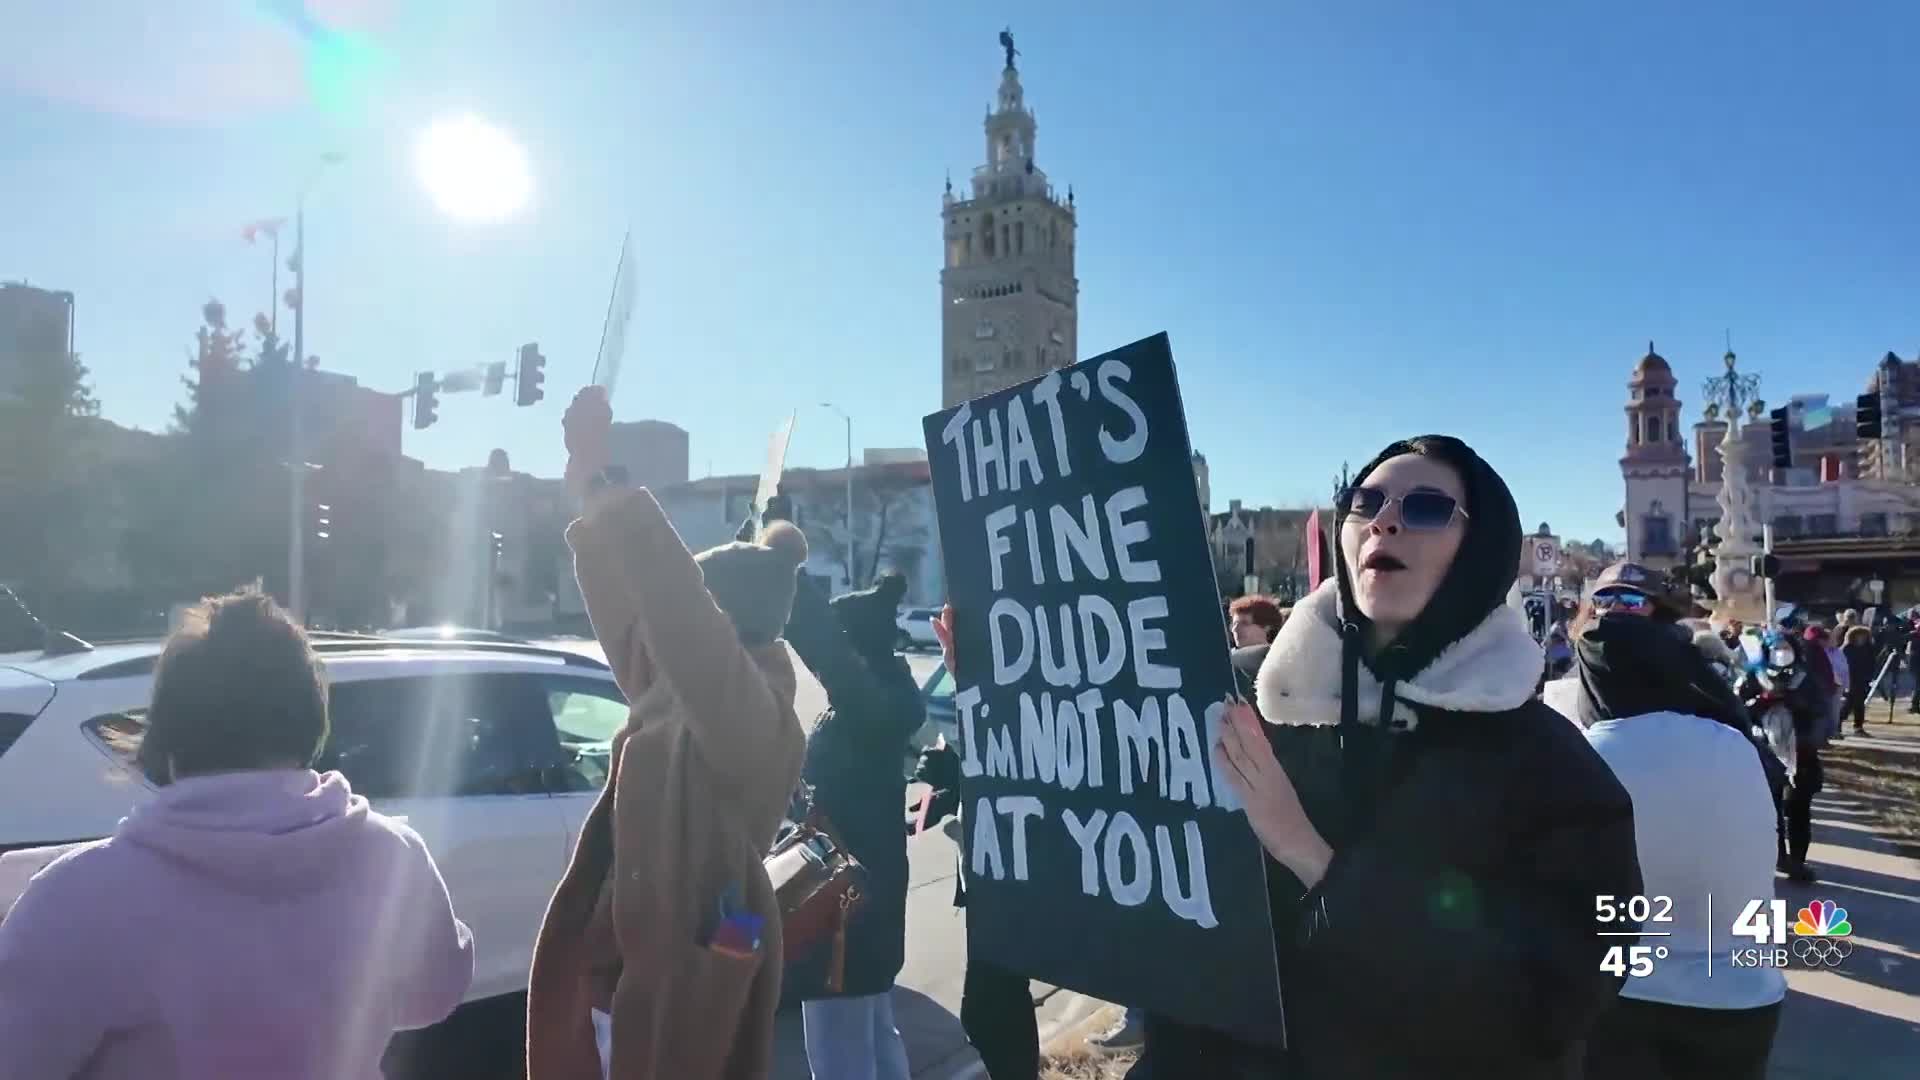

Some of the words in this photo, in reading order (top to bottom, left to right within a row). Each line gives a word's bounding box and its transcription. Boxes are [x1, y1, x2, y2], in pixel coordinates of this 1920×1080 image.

[943, 359, 1149, 502] THAT'S
[985, 486, 1161, 591] FINE
[988, 595, 1182, 688] DUDE
[1019, 688, 1104, 790] NOT
[972, 796, 1044, 881] AT
[1061, 808, 1219, 929] YOU
